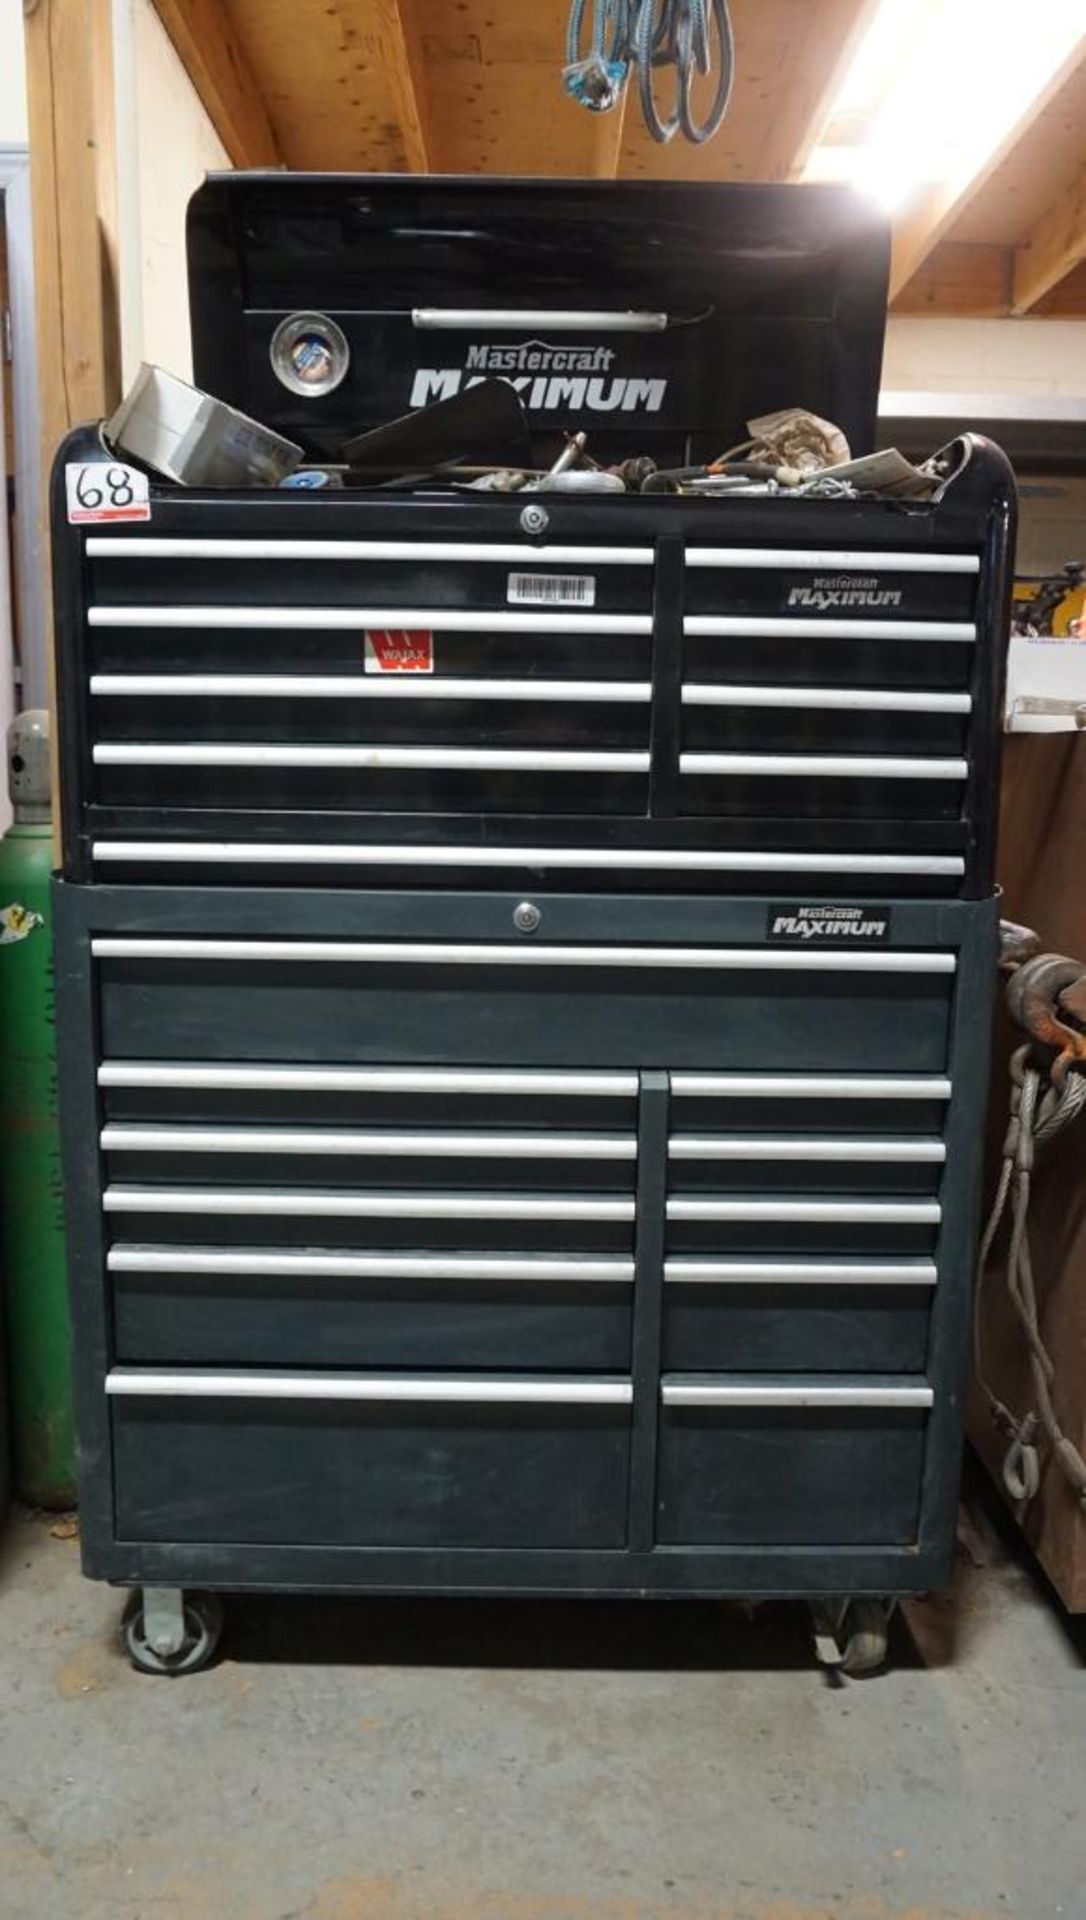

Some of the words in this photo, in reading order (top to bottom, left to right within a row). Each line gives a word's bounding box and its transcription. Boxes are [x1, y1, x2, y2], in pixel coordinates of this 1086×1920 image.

[466, 345, 616, 371] Mastercraft
[409, 368, 668, 412] MXIMUM
[76, 466, 134, 509] 68
[788, 588, 902, 610] MAXIMUM
[382, 648, 426, 662] WAJAX
[798, 907, 864, 919] Mastercraft
[773, 917, 886, 939] MAXIMUM
